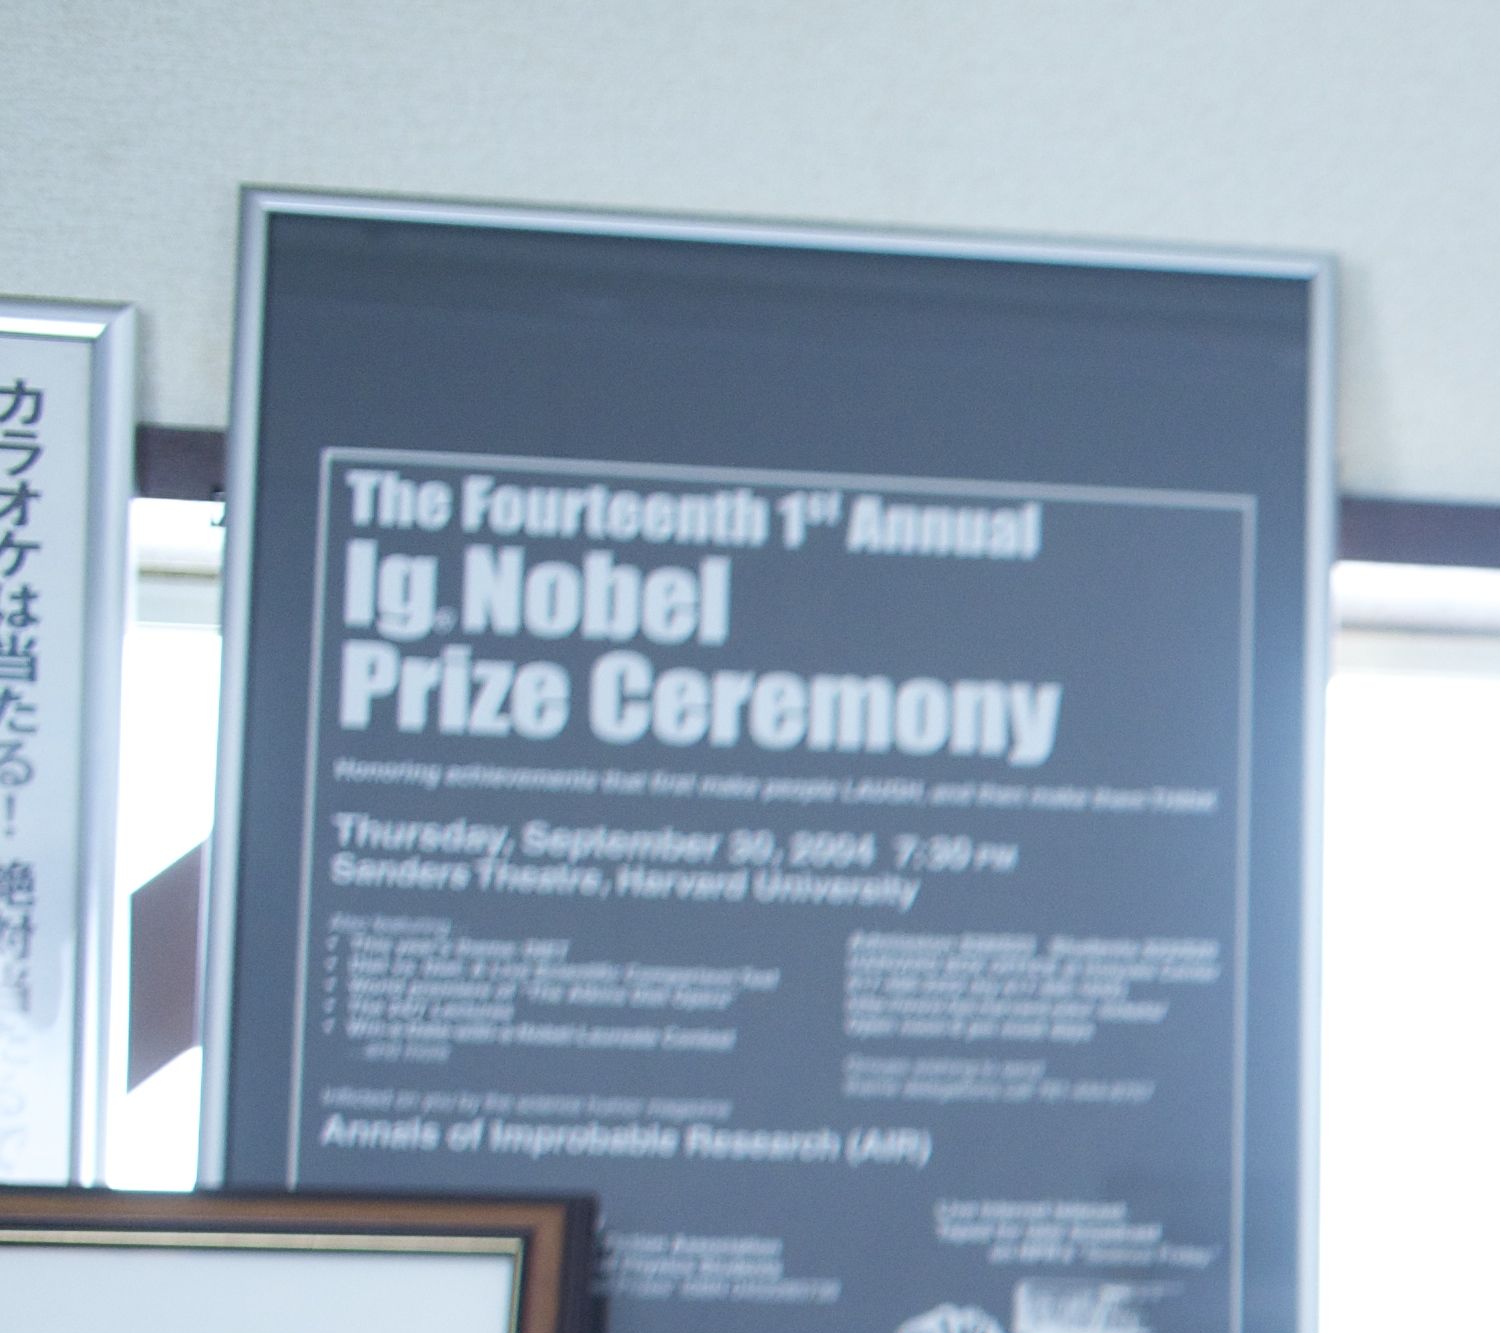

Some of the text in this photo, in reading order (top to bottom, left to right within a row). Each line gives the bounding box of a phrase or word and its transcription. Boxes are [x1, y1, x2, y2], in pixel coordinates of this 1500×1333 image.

[345, 467, 453, 532] The
[461, 474, 770, 549] Fourteenth
[845, 494, 1043, 561] Annual
[461, 543, 733, 648] Nobel
[339, 638, 1062, 769] Prize Ceremony
[331, 811, 516, 858] Thursday,
[521, 820, 723, 864] September
[330, 852, 472, 893] Sanders
[614, 865, 749, 902] Harvard
[752, 871, 920, 913] University
[445, 1117, 486, 1153] of
[684, 1124, 841, 1164] Research
